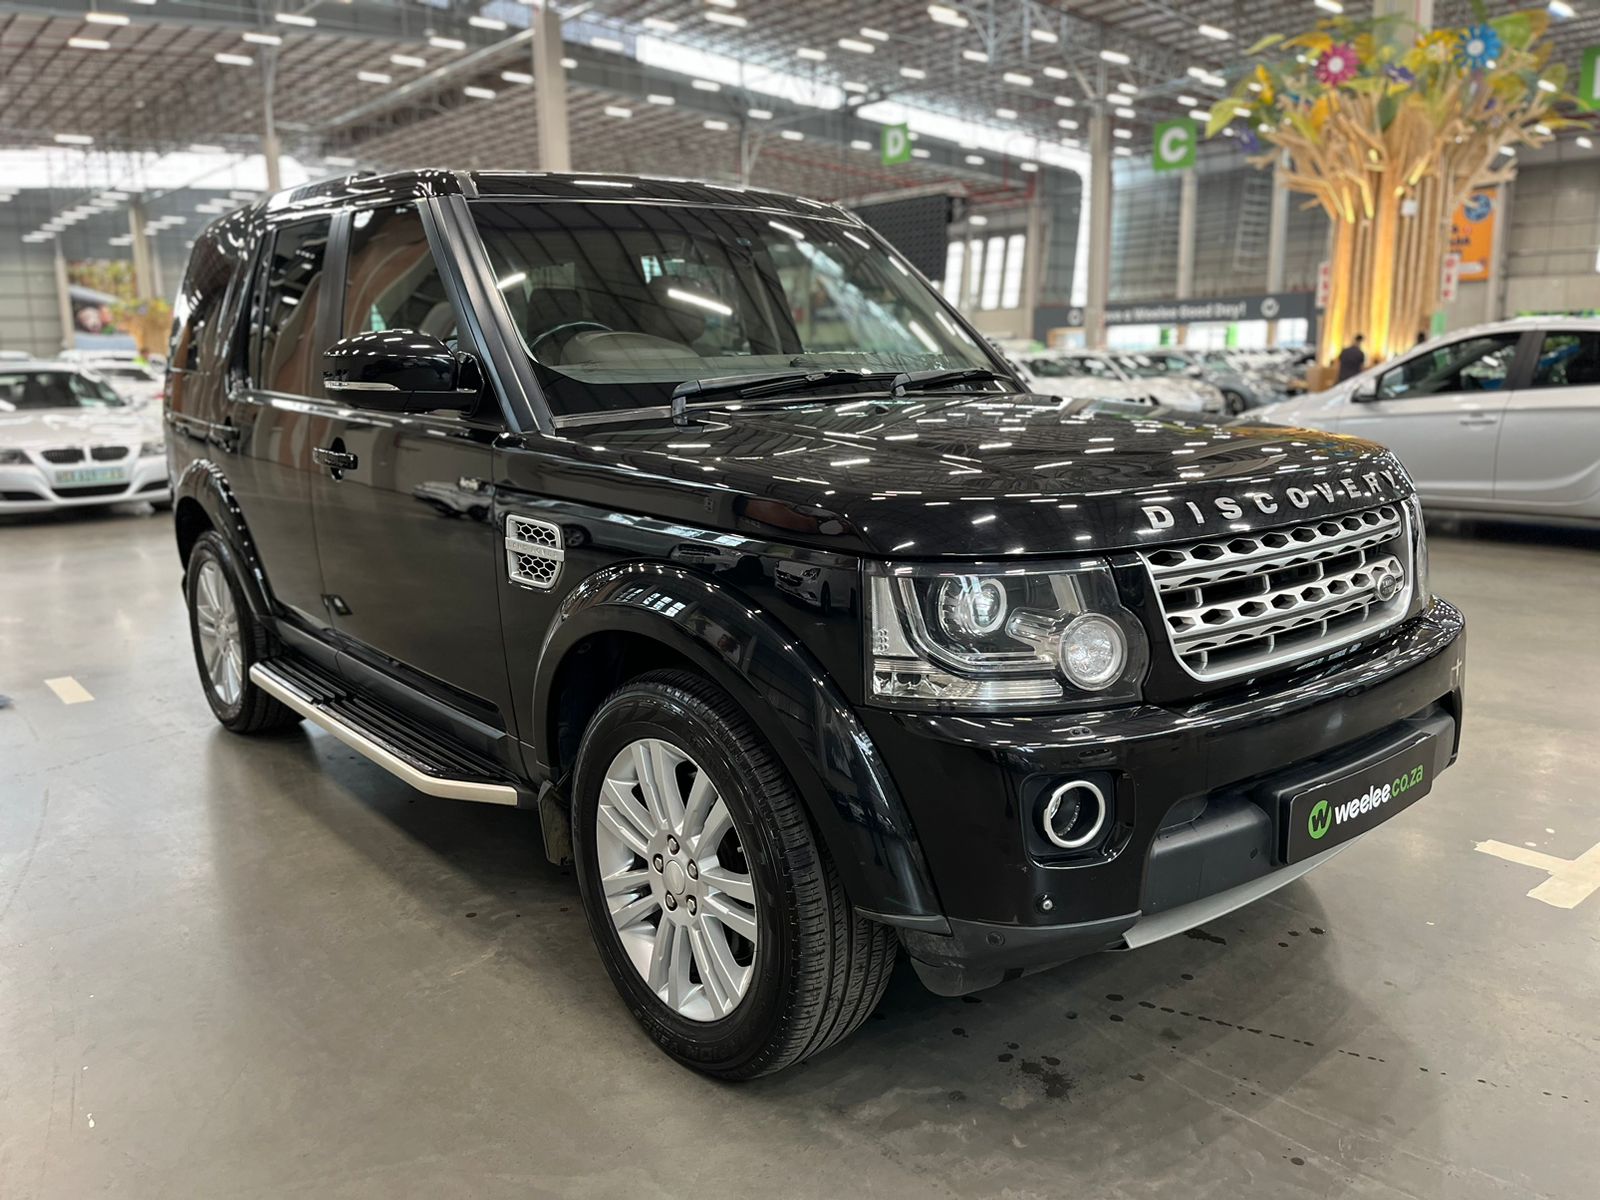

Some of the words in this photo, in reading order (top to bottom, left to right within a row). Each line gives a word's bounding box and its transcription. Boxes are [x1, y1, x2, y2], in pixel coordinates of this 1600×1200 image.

[886, 129, 905, 158] D
[1160, 126, 1189, 163] C
[1141, 469, 1398, 529] DISCOVERY
[1335, 764, 1424, 825] weelee.co.za
